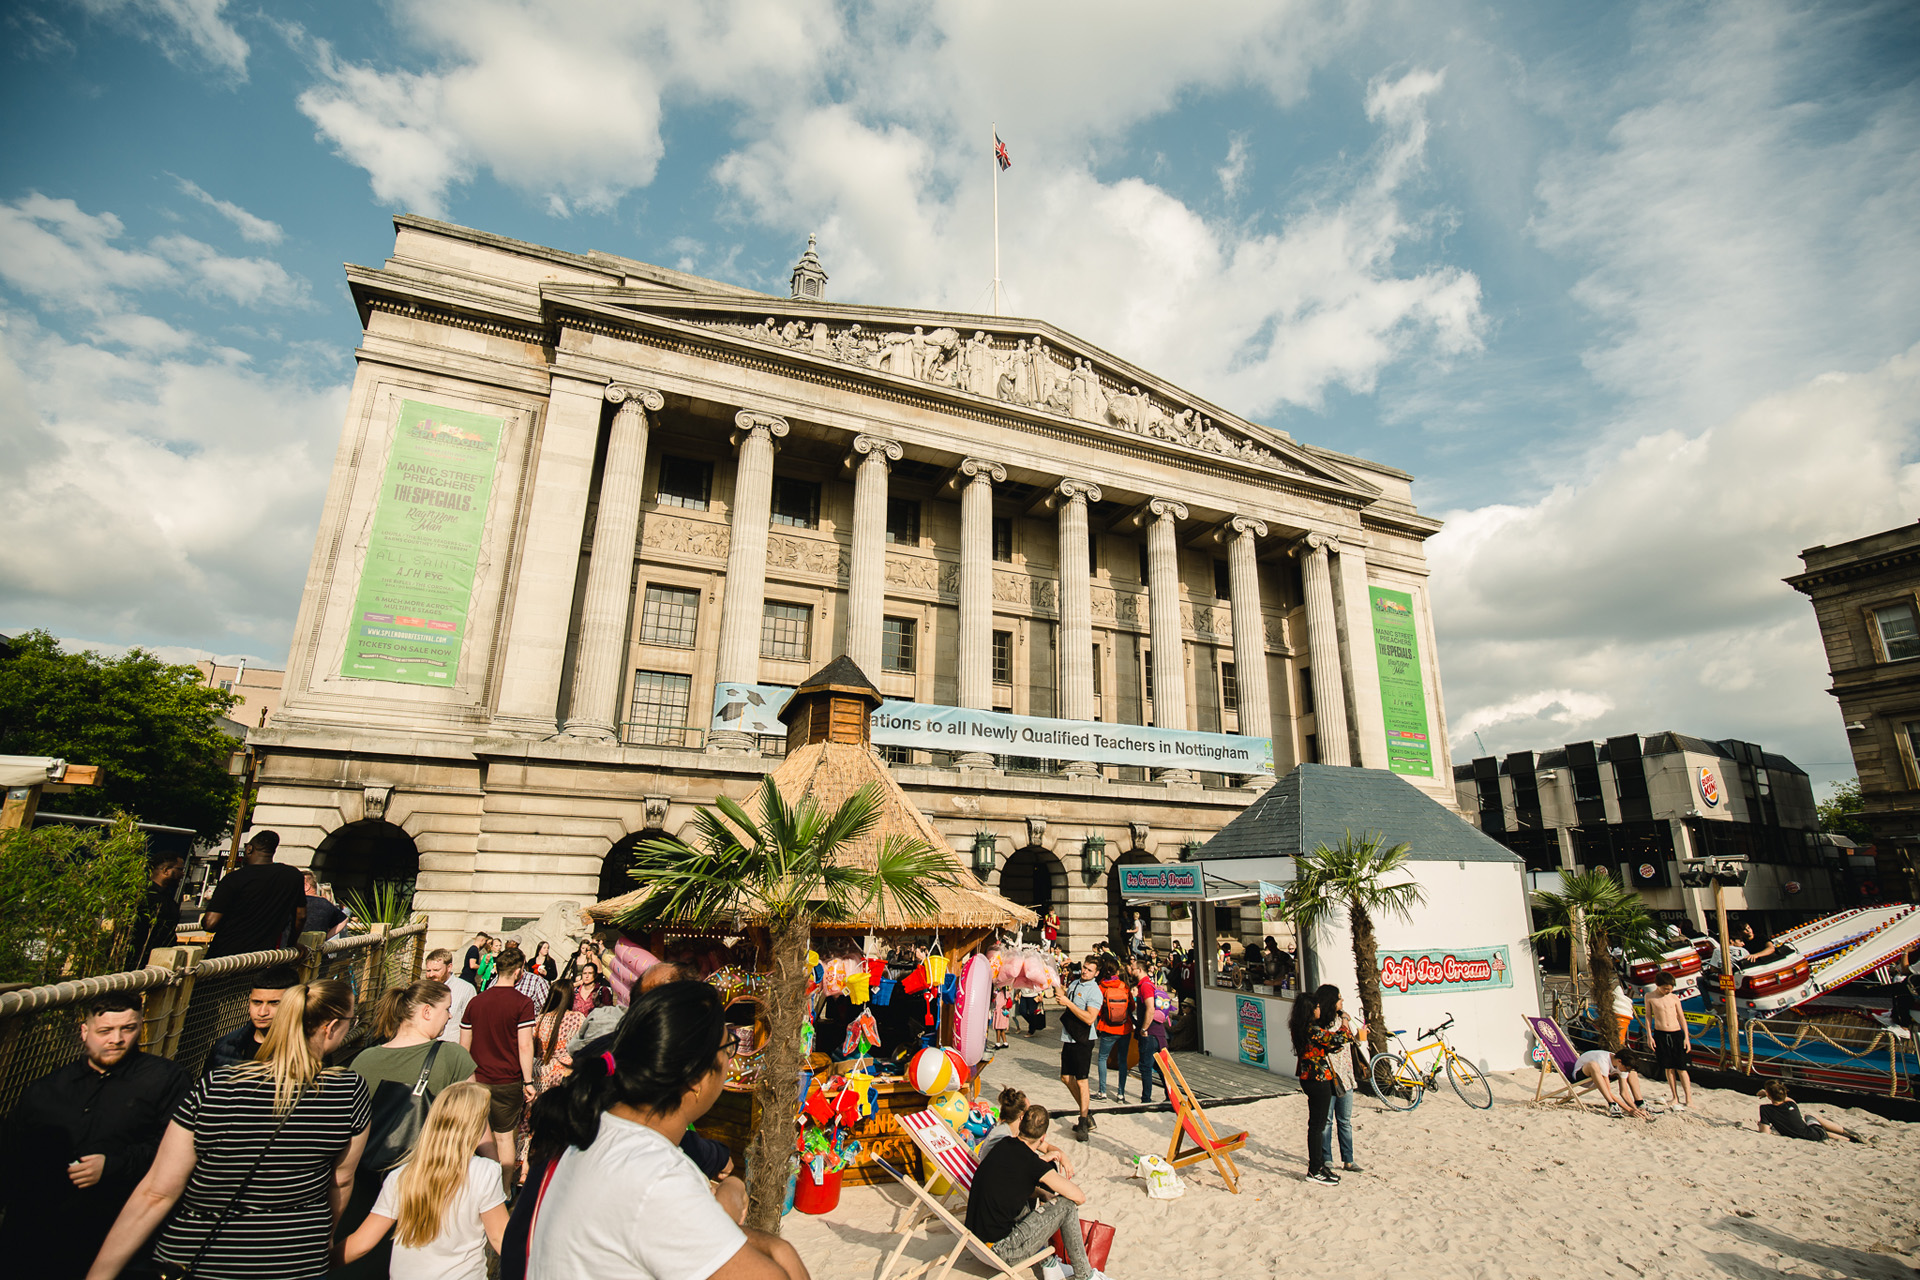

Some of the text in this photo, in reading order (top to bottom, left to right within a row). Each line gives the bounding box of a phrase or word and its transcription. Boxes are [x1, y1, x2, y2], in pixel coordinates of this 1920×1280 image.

[397, 462, 485, 484] MANIC STREET
[403, 472, 475, 492] PREACHERS
[394, 484, 471, 512] THE SPECIALS
[375, 550, 469, 572] ALL SAINTS
[396, 566, 421, 578] ASH
[380, 596, 402, 604] MUCH
[403, 599, 425, 607] MORE
[426, 602, 453, 611] ACROSS
[383, 603, 442, 615] MULTIPLE STAGES
[1376, 628, 1413, 640] MANIC STREET
[1380, 635, 1411, 646] PREACHERS
[357, 639, 451, 656] TICKETS ON SALE NOW
[1387, 645, 1412, 659] SPECIALS
[870, 712, 921, 732] ations
[926, 718, 942, 733] to
[947, 720, 966, 735] all
[972, 722, 1018, 743] Newly
[1022, 727, 1089, 747] Qualified
[1093, 734, 1155, 753] Teachers
[1160, 740, 1171, 754] in
[1175, 741, 1249, 760] Nottingham
[1127, 872, 1194, 887] Ice Cream & Donuts
[1382, 956, 1491, 991] Soft Ice Cream
